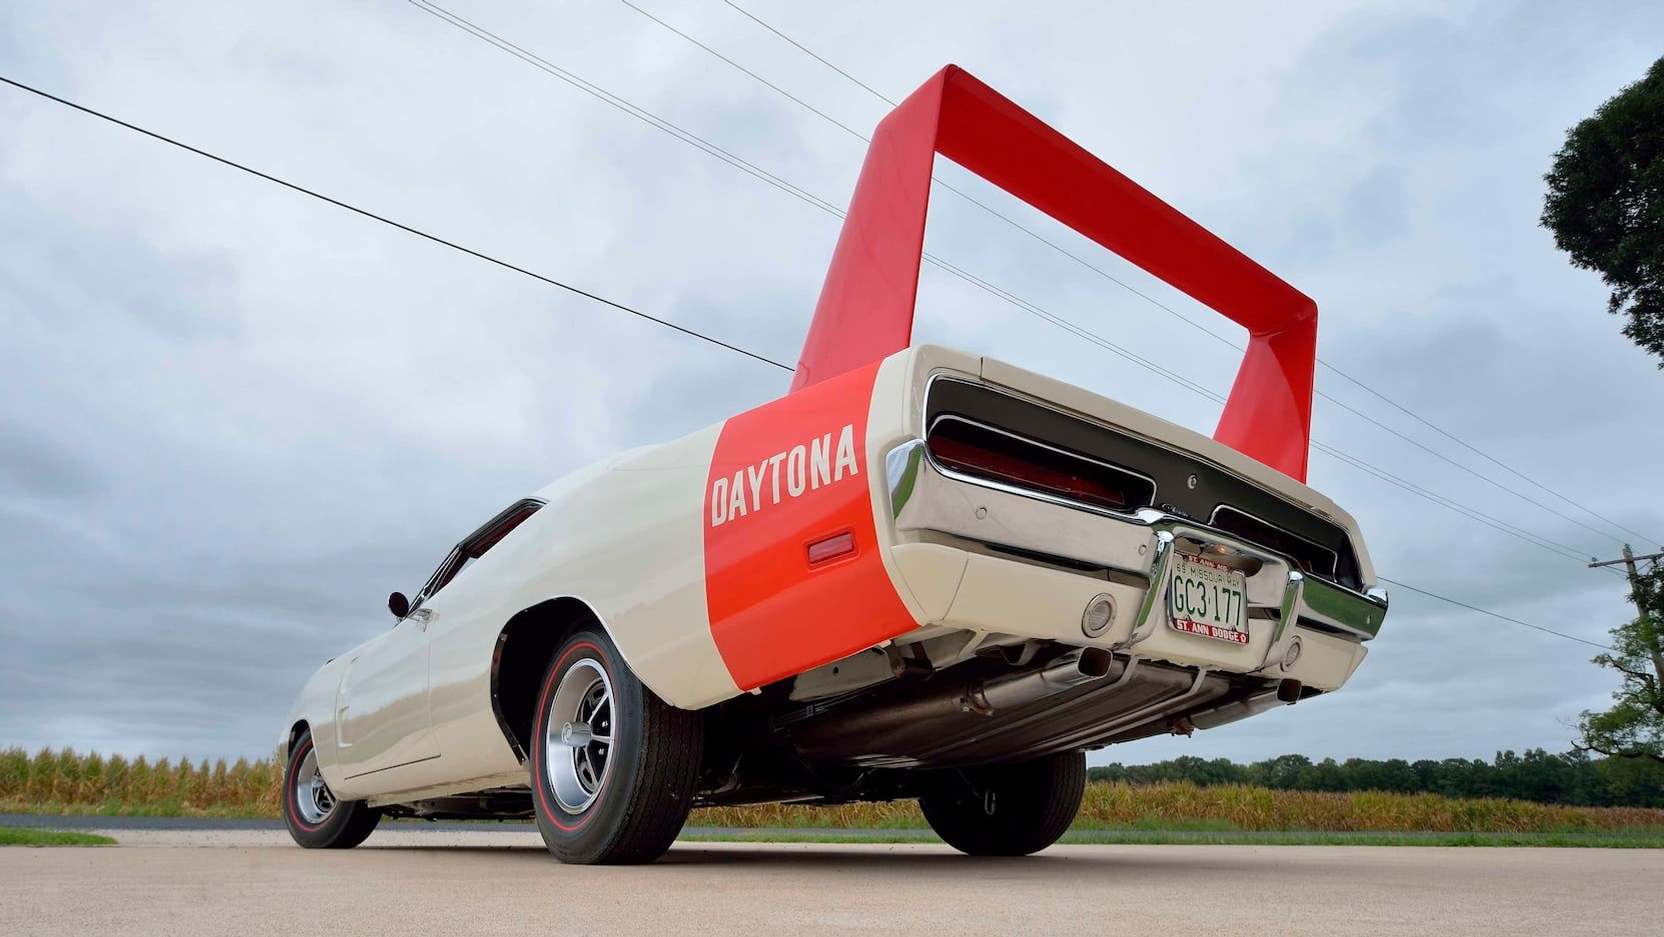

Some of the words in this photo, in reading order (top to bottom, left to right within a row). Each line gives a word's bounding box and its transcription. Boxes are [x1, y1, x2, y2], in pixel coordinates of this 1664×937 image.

[711, 423, 859, 528] DAYTONA
[1190, 567, 1225, 583] MISSOURI
[1177, 619, 1190, 631] ST.
[1191, 622, 1210, 635] ANN
[1212, 627, 1239, 642] DODGE
